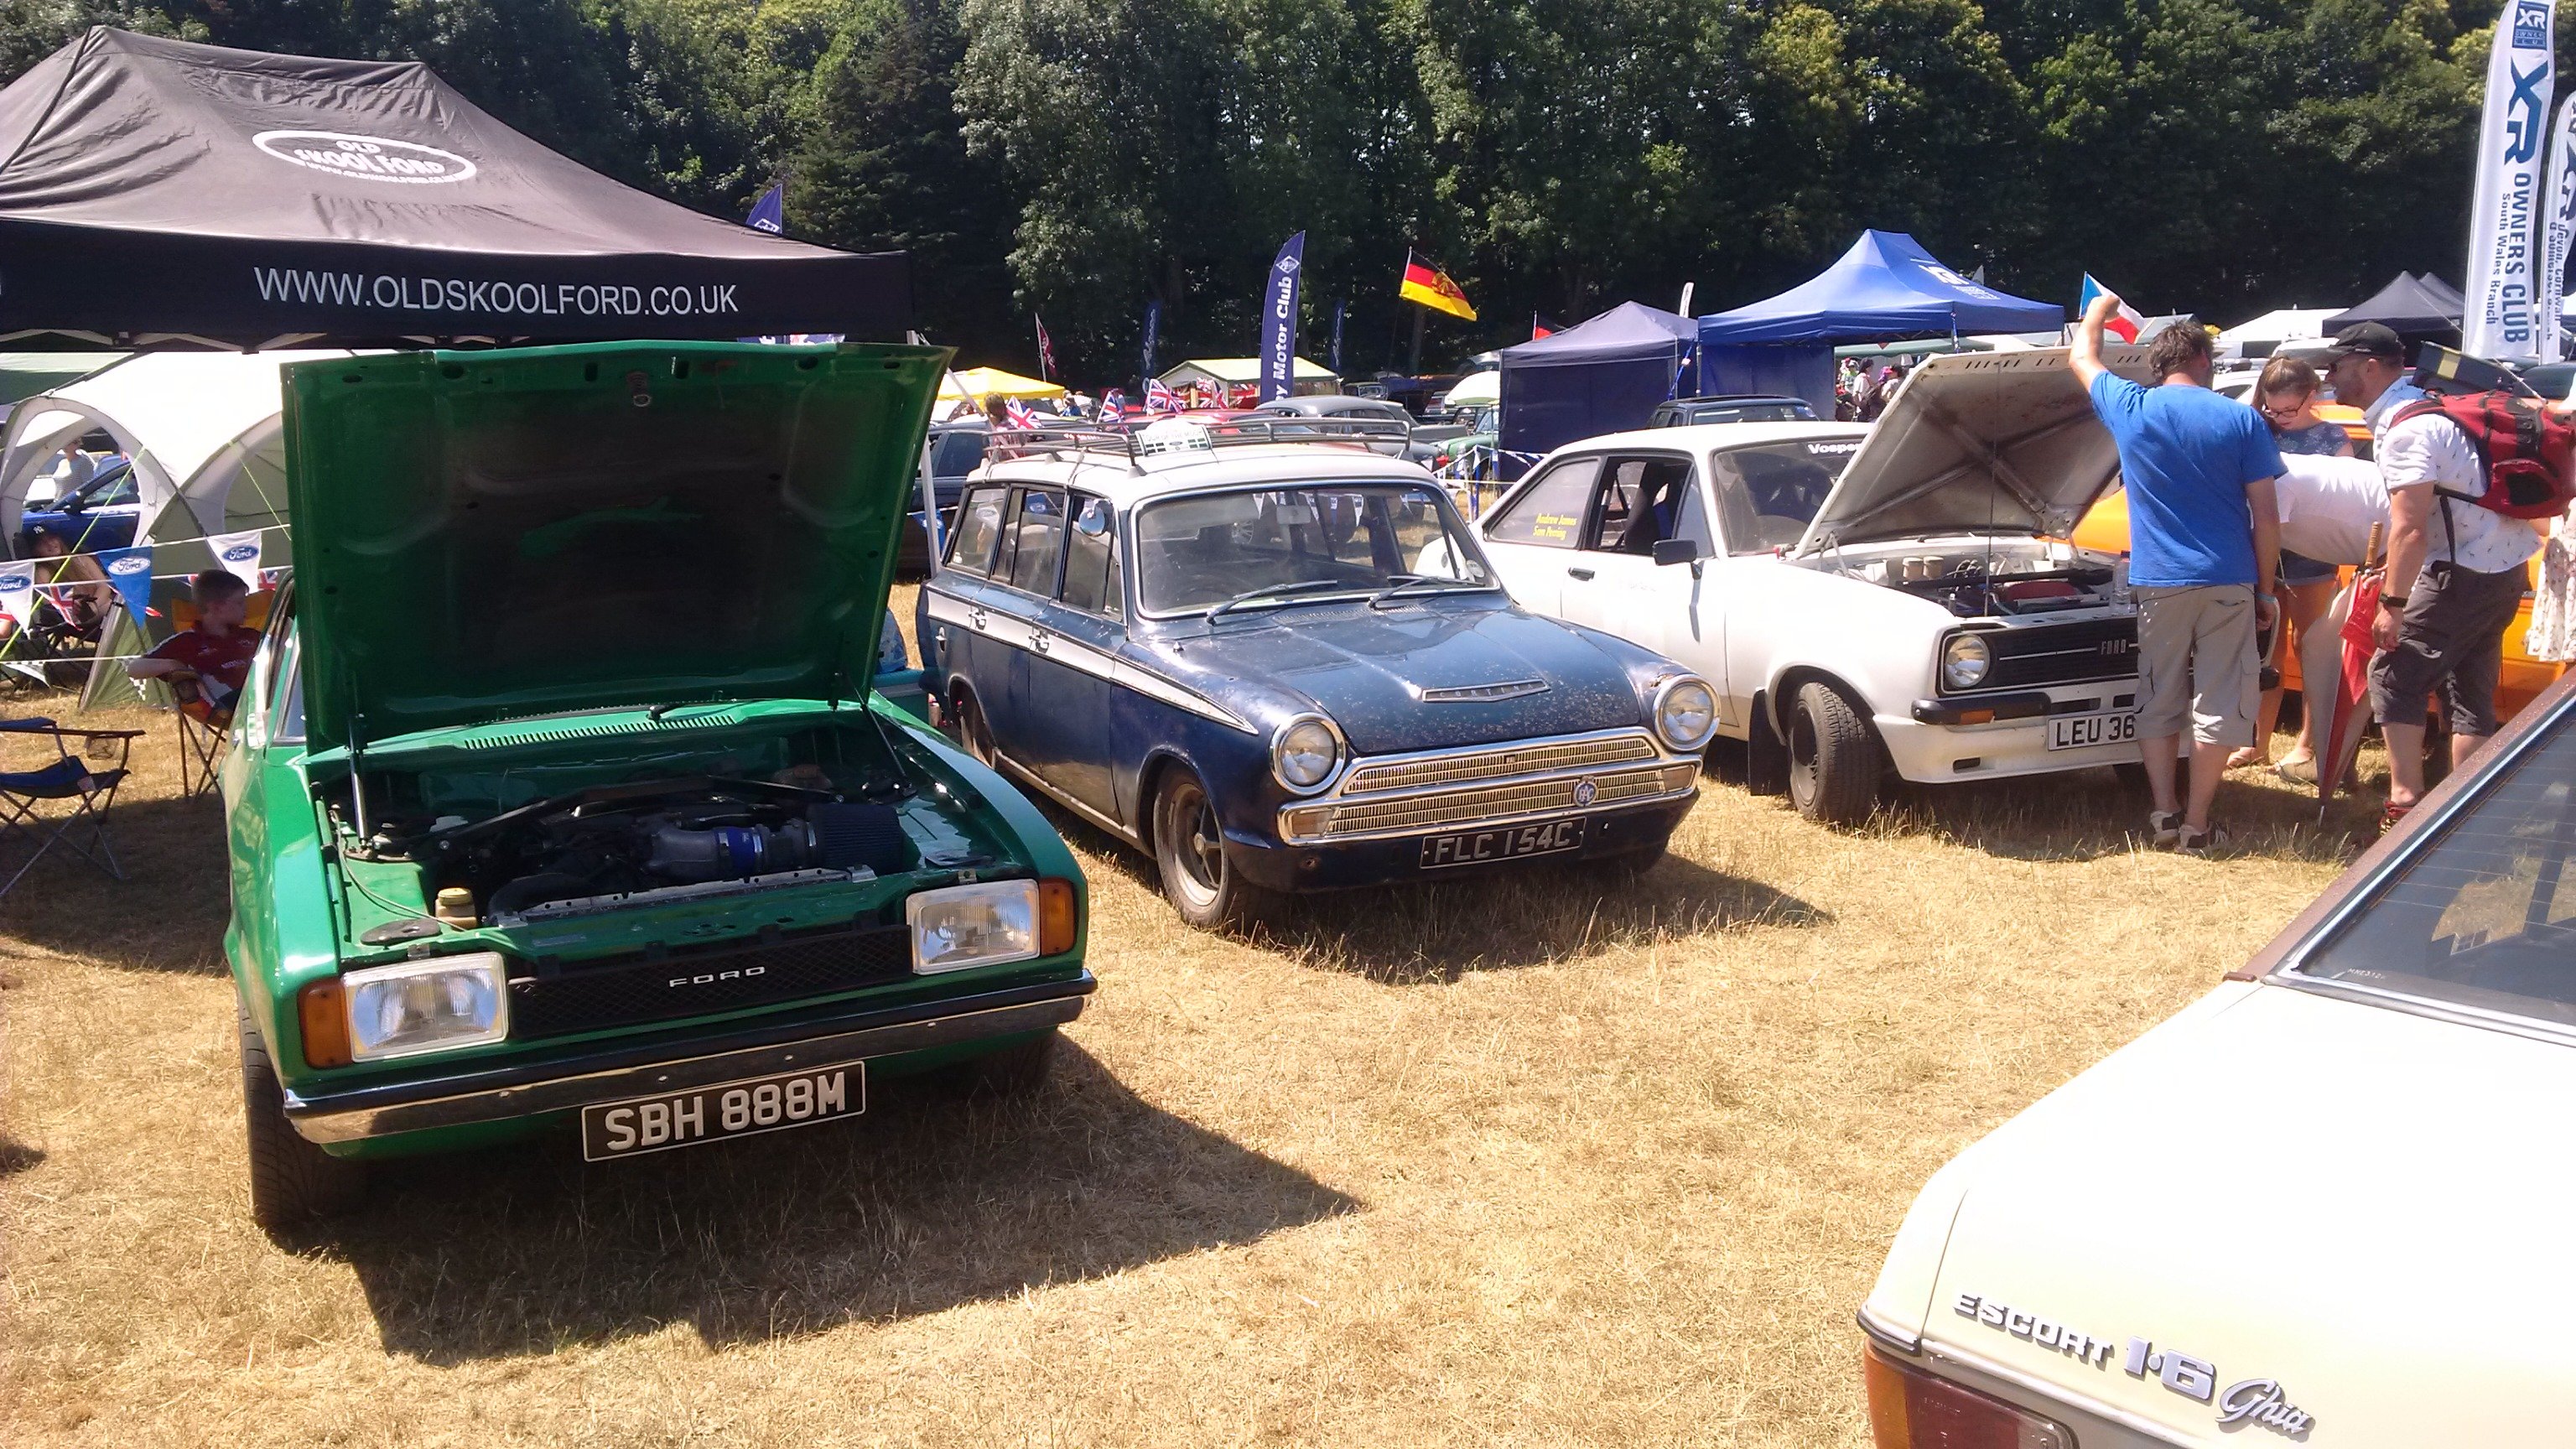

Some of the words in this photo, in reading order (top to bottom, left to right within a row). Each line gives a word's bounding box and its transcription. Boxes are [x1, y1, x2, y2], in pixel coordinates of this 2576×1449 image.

[2516, 8, 2546, 29] XR
[2504, 56, 2548, 165] XR
[294, 149, 385, 173] SKOOL
[374, 154, 445, 174] FORD
[336, 141, 381, 153] OLD
[2499, 193, 2511, 231] South
[2505, 173, 2532, 275] OWNERS
[2493, 236, 2508, 275] Wales
[254, 266, 738, 314] WWW.OLDSKOOLFORD.CO.UK
[1277, 276, 1292, 319] Club
[2486, 280, 2501, 325] Branch
[2501, 283, 2530, 343] CLUB
[1273, 323, 1287, 381] Motor
[2101, 639, 2127, 655] FORD
[1440, 683, 1534, 698] CORTINA
[2056, 718, 2101, 747] LEU
[1434, 833, 1493, 864] FLC
[1504, 822, 1573, 855] 154C
[669, 966, 766, 988] FORD
[605, 1095, 704, 1151] SBH
[721, 1071, 846, 1132] 888M
[1953, 1293, 2115, 1369] ESCORT
[2215, 1379, 2313, 1434] Ghia
